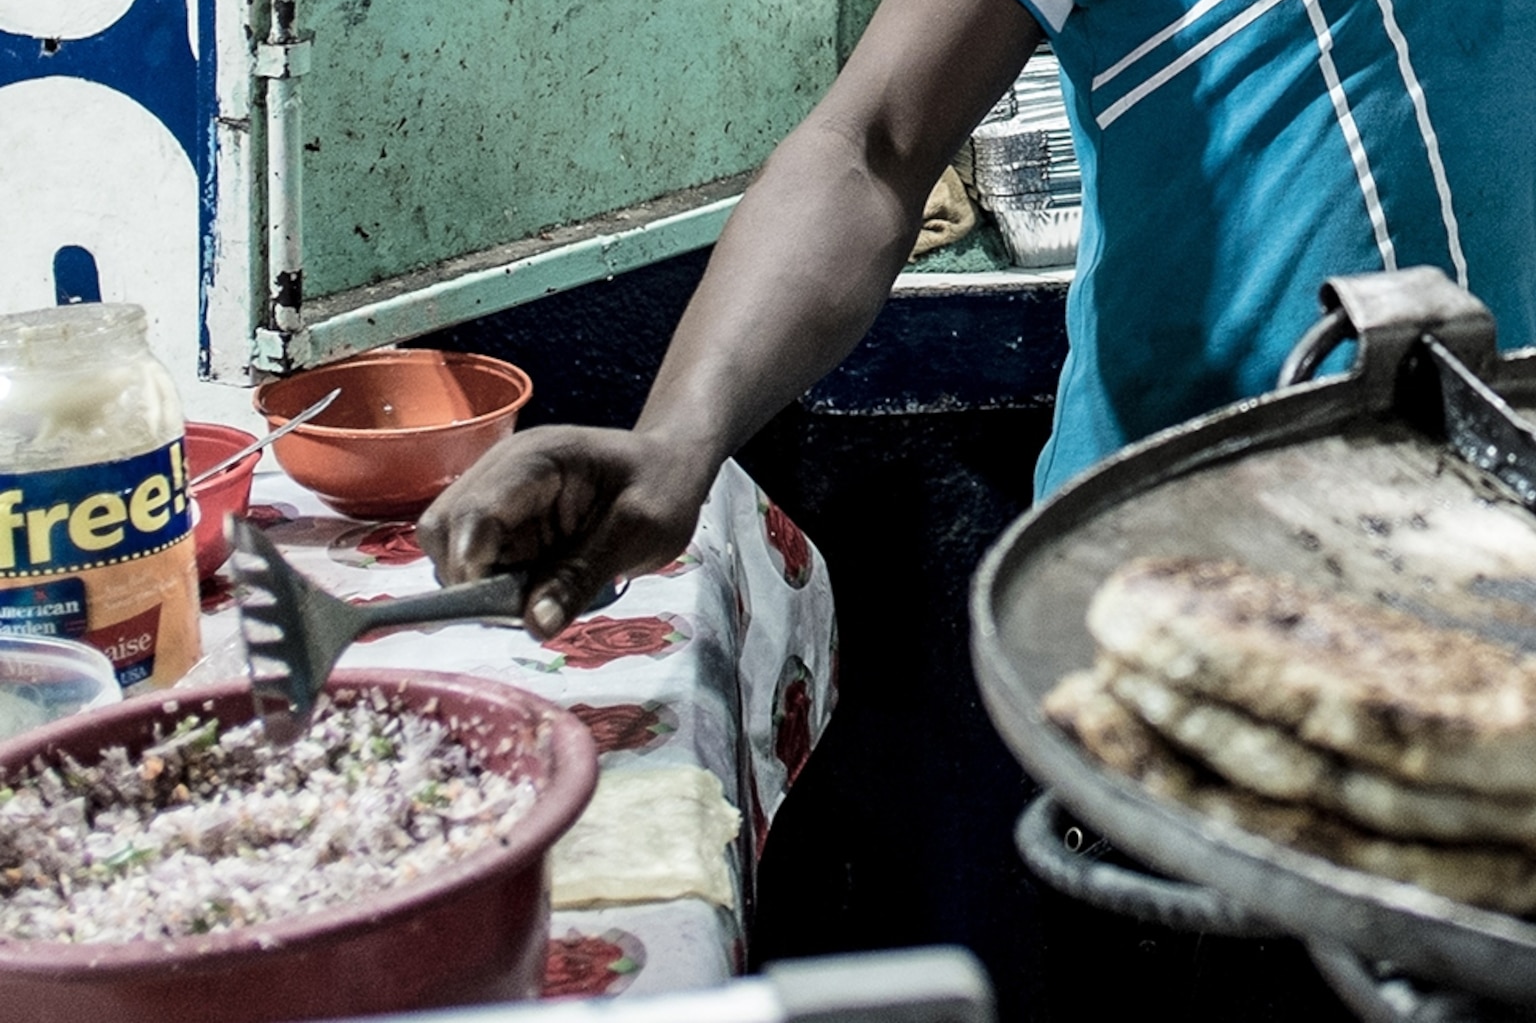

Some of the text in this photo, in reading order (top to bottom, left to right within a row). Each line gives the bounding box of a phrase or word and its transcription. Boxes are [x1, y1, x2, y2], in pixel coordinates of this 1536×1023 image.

[0, 442, 187, 569] free!
[0, 600, 80, 619] merican
[0, 620, 57, 635] arden
